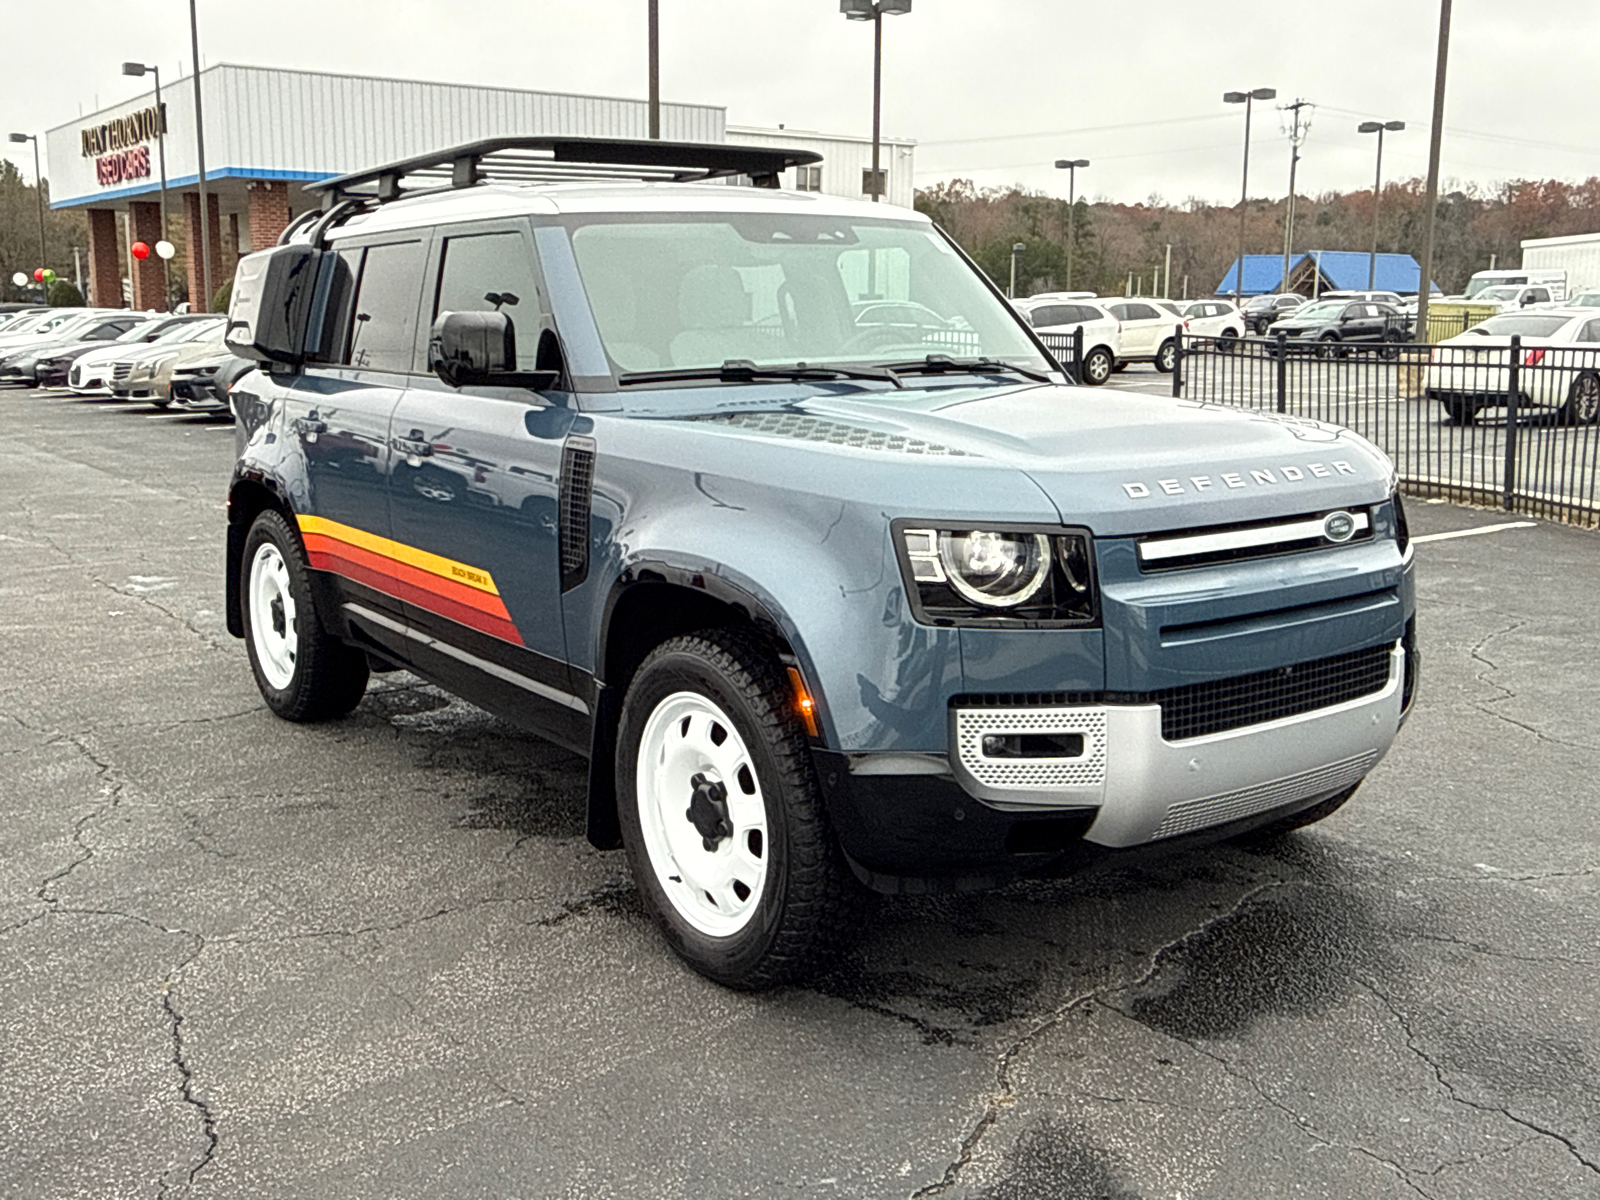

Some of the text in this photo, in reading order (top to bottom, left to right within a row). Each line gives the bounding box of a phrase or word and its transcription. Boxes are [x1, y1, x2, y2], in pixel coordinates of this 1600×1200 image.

[96, 145, 151, 186] USED CARS
[1122, 460, 1357, 499] DEFENDER
